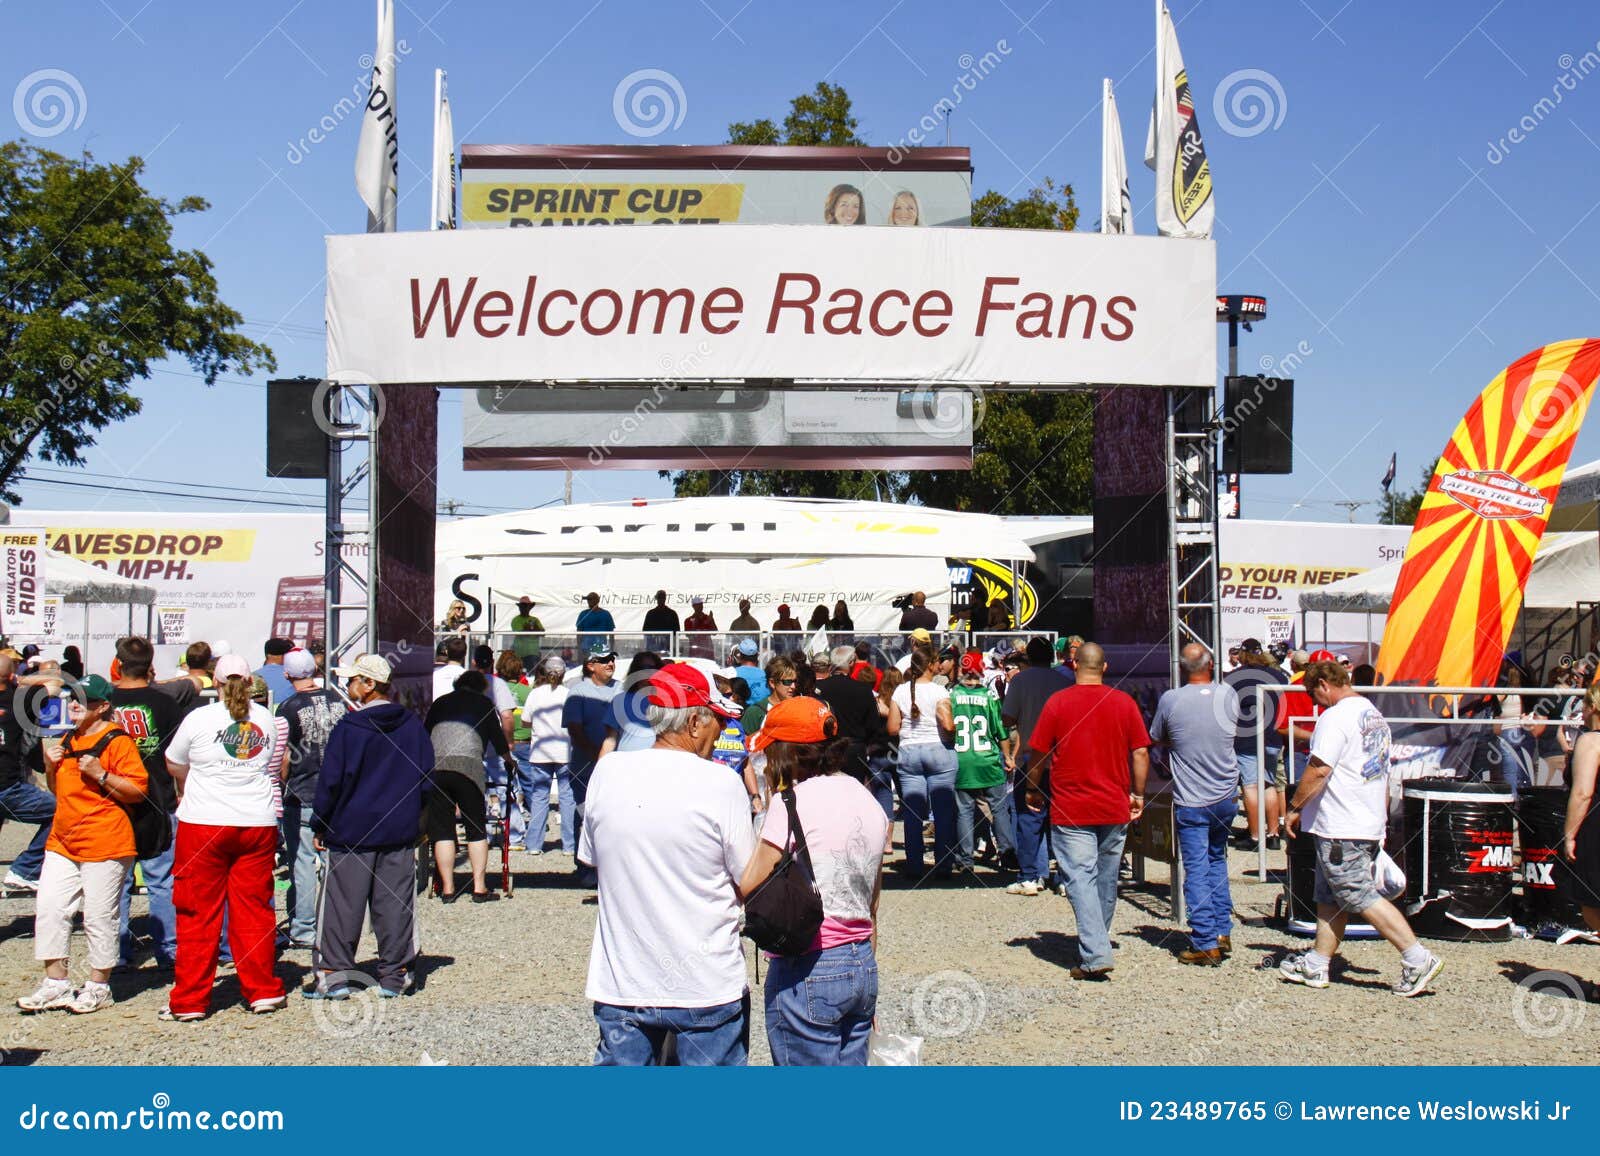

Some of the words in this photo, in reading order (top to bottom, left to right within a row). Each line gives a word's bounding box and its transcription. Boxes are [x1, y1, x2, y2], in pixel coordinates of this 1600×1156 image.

[486, 188, 620, 213] SPRINT
[627, 188, 702, 213] CUP
[409, 273, 745, 339] Welcome
[766, 272, 953, 338] Race
[974, 275, 1137, 341] Fans
[3, 535, 38, 546] FREE
[1378, 545, 1406, 562] Spri
[116, 559, 194, 581] MPH.
[1240, 567, 1297, 584] YOUR
[1302, 570, 1361, 586] NEE
[7, 548, 17, 616] SIMULATOR
[19, 549, 37, 616] RIDES
[1220, 585, 1283, 600] PEED.
[620, 593, 672, 605] HELMT
[676, 592, 772, 605] SWEPSTAKES
[782, 592, 826, 603] ENTER
[828, 592, 846, 602] TO
[849, 592, 875, 602] WIN
[954, 714, 992, 753] 32
